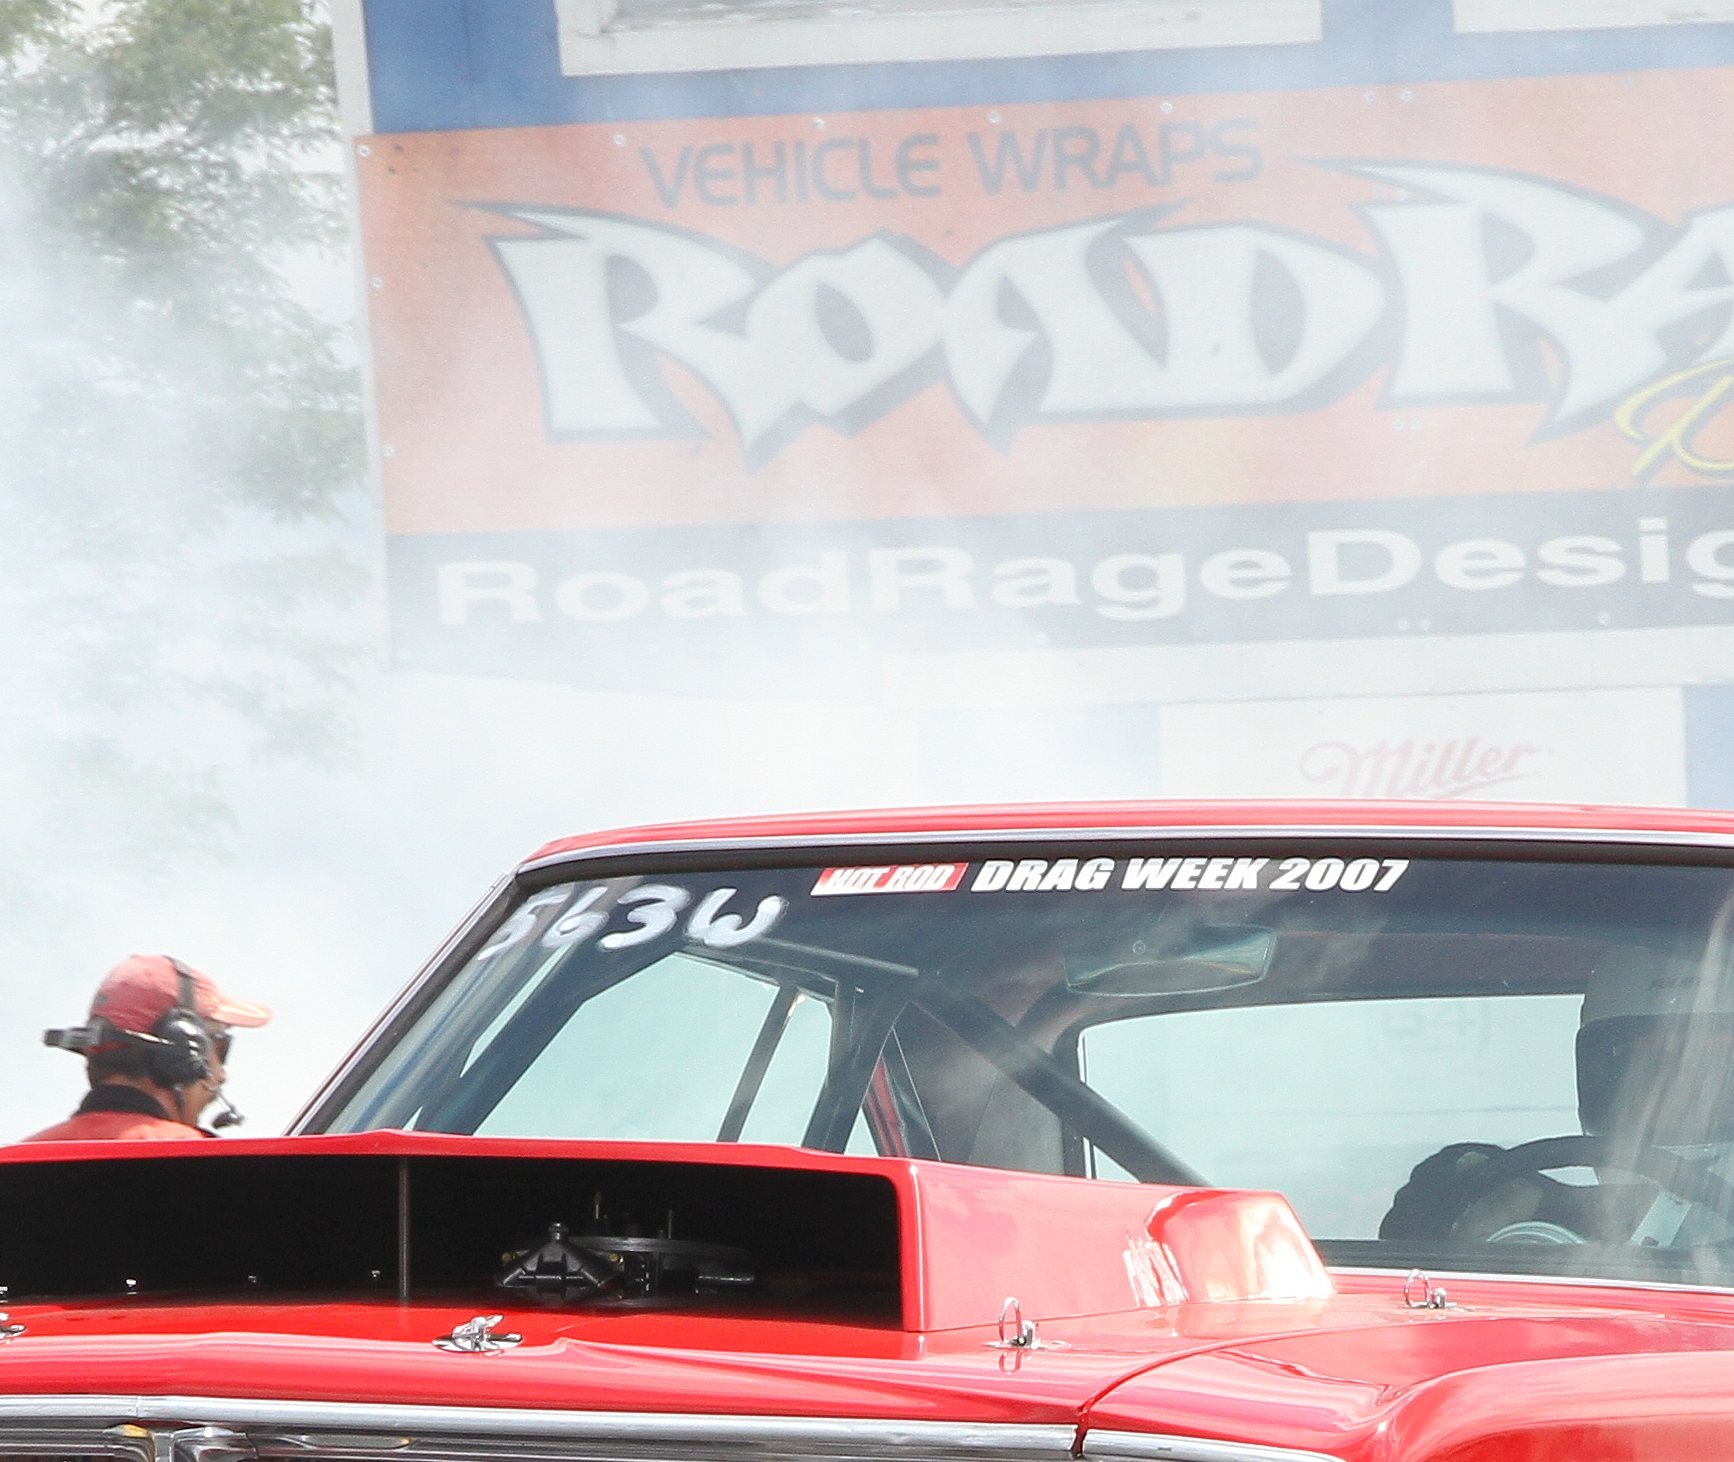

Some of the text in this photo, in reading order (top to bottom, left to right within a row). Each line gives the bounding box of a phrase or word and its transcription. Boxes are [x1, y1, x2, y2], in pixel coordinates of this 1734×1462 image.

[640, 118, 1263, 210] VEHICLE WRAPS
[1300, 733, 1542, 799] Miller
[830, 857, 1409, 893] HOT ROD DRAG WEEK 2007
[477, 882, 790, 961] 563W
